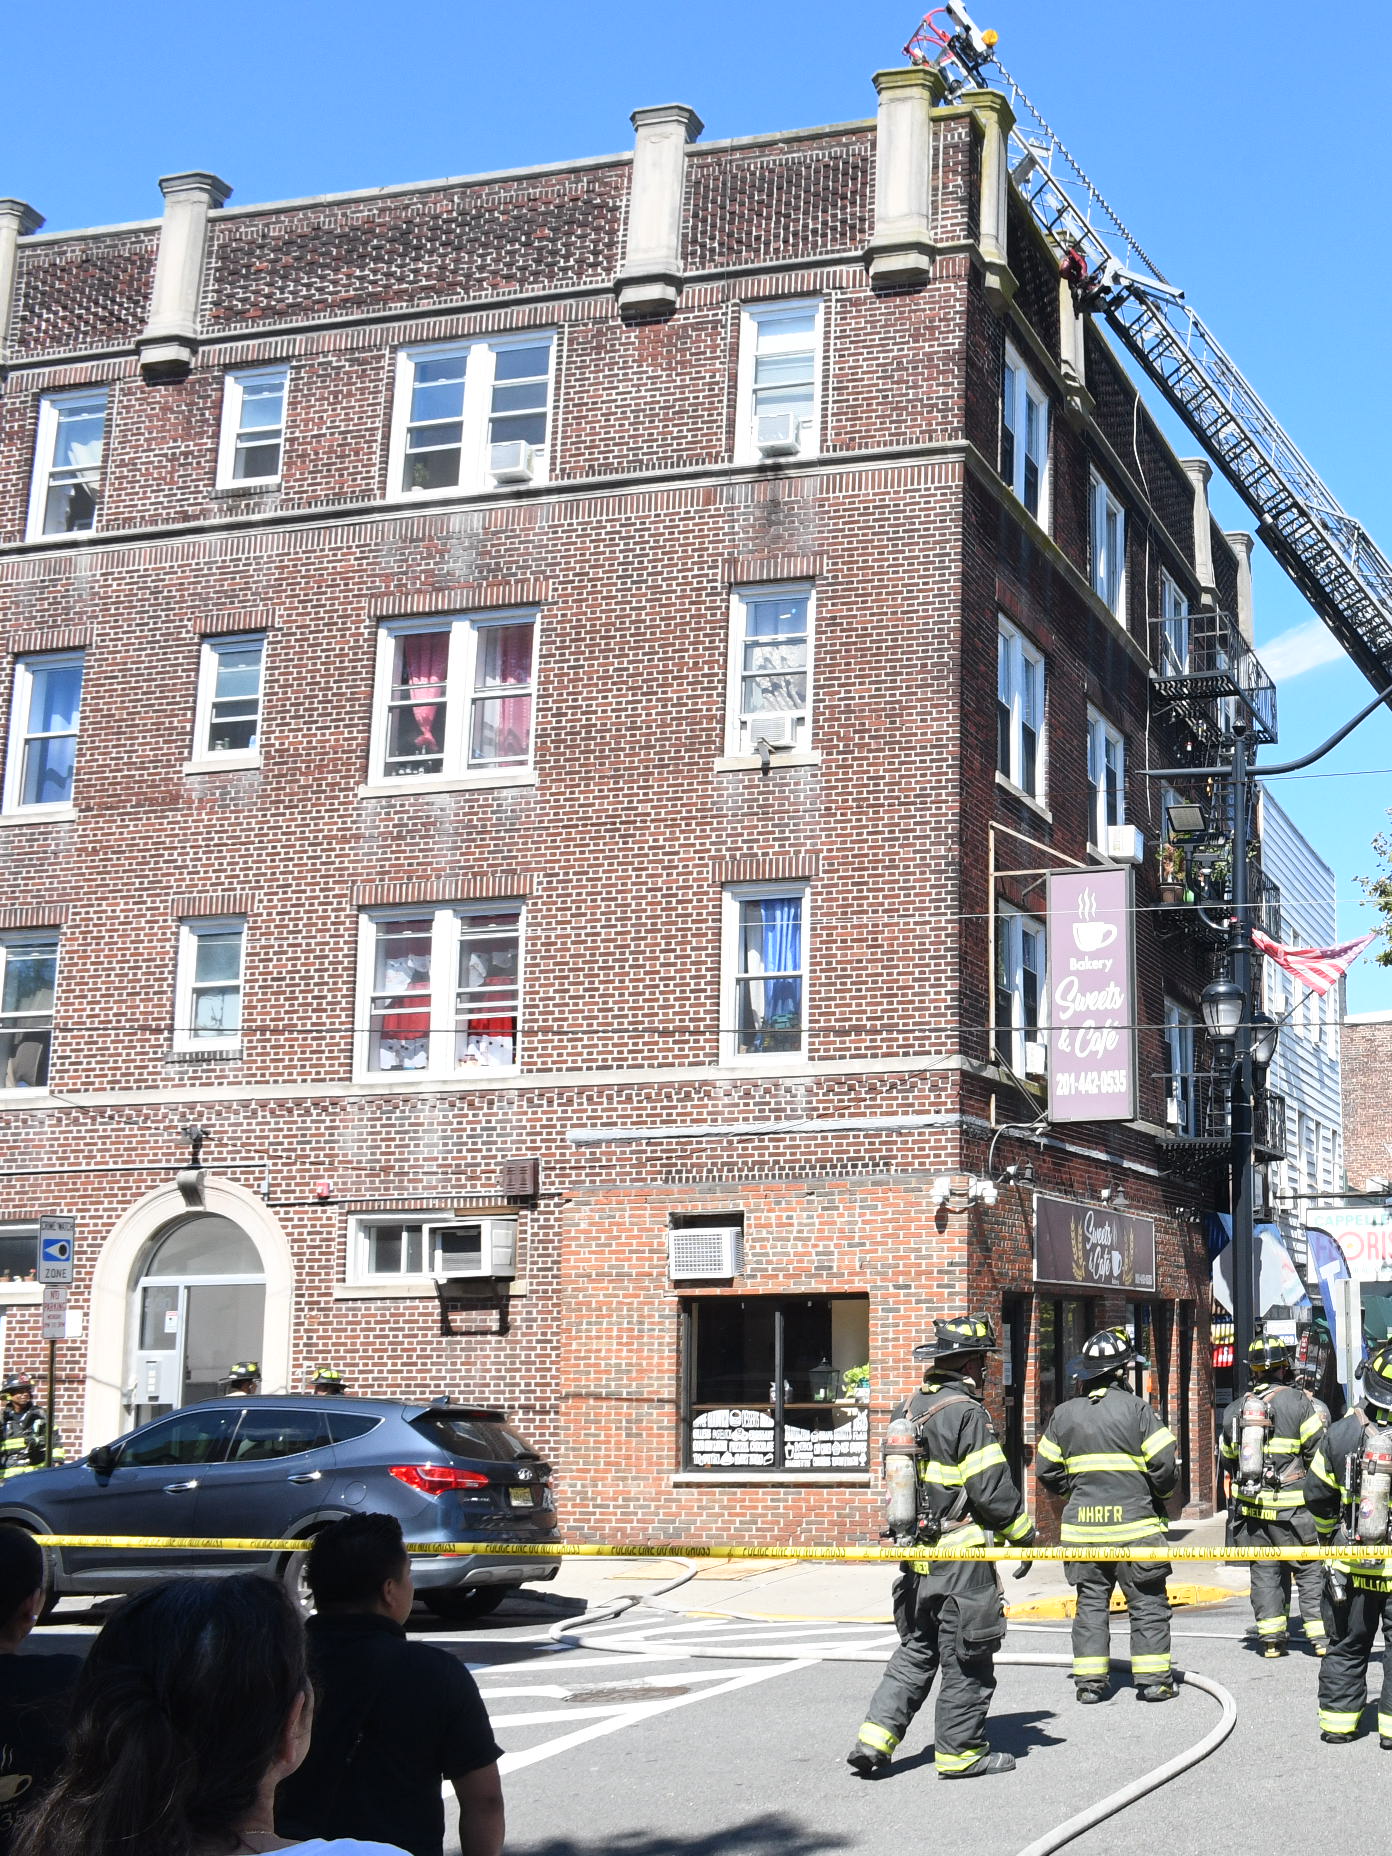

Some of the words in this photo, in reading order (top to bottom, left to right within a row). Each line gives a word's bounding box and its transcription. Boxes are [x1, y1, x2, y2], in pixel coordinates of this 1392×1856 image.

[1069, 956, 1113, 972] Bakery
[1055, 976, 1124, 1020] Sweets
[1058, 1025, 1071, 1052] &
[1074, 1018, 1122, 1059] Café
[1056, 1070, 1126, 1096] 201-442-0535
[1084, 1210, 1112, 1250] Sweets
[45, 1268, 68, 1279] ZONE
[51, 1290, 60, 1299] NO
[1077, 1506, 1123, 1523] NHRFR
[1241, 1506, 1277, 1521] SHELTON
